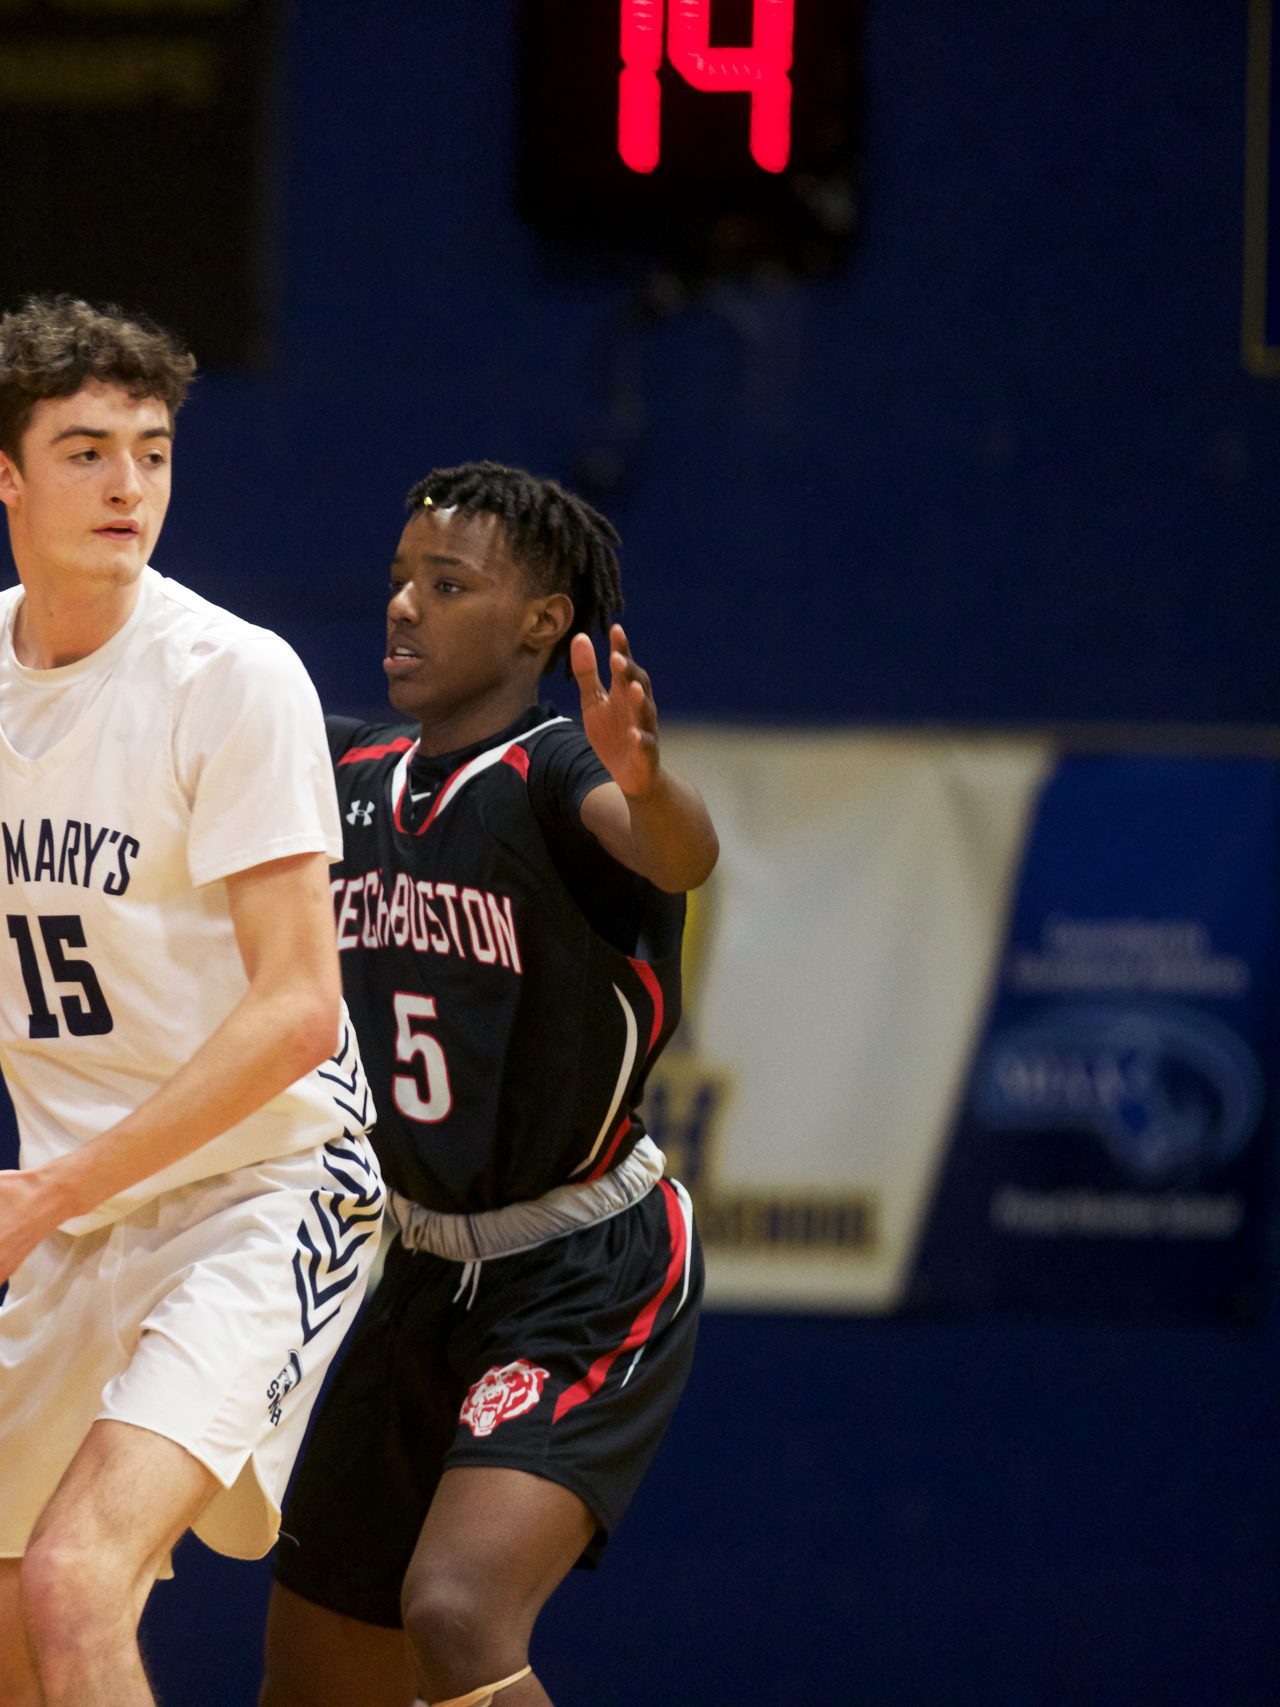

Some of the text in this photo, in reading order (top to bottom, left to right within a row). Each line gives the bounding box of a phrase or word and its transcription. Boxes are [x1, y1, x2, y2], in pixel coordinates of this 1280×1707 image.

[618, 0, 794, 174] 14
[2, 818, 140, 896] MARY'S
[6, 914, 114, 1038] 15
[391, 990, 454, 1124] 5
